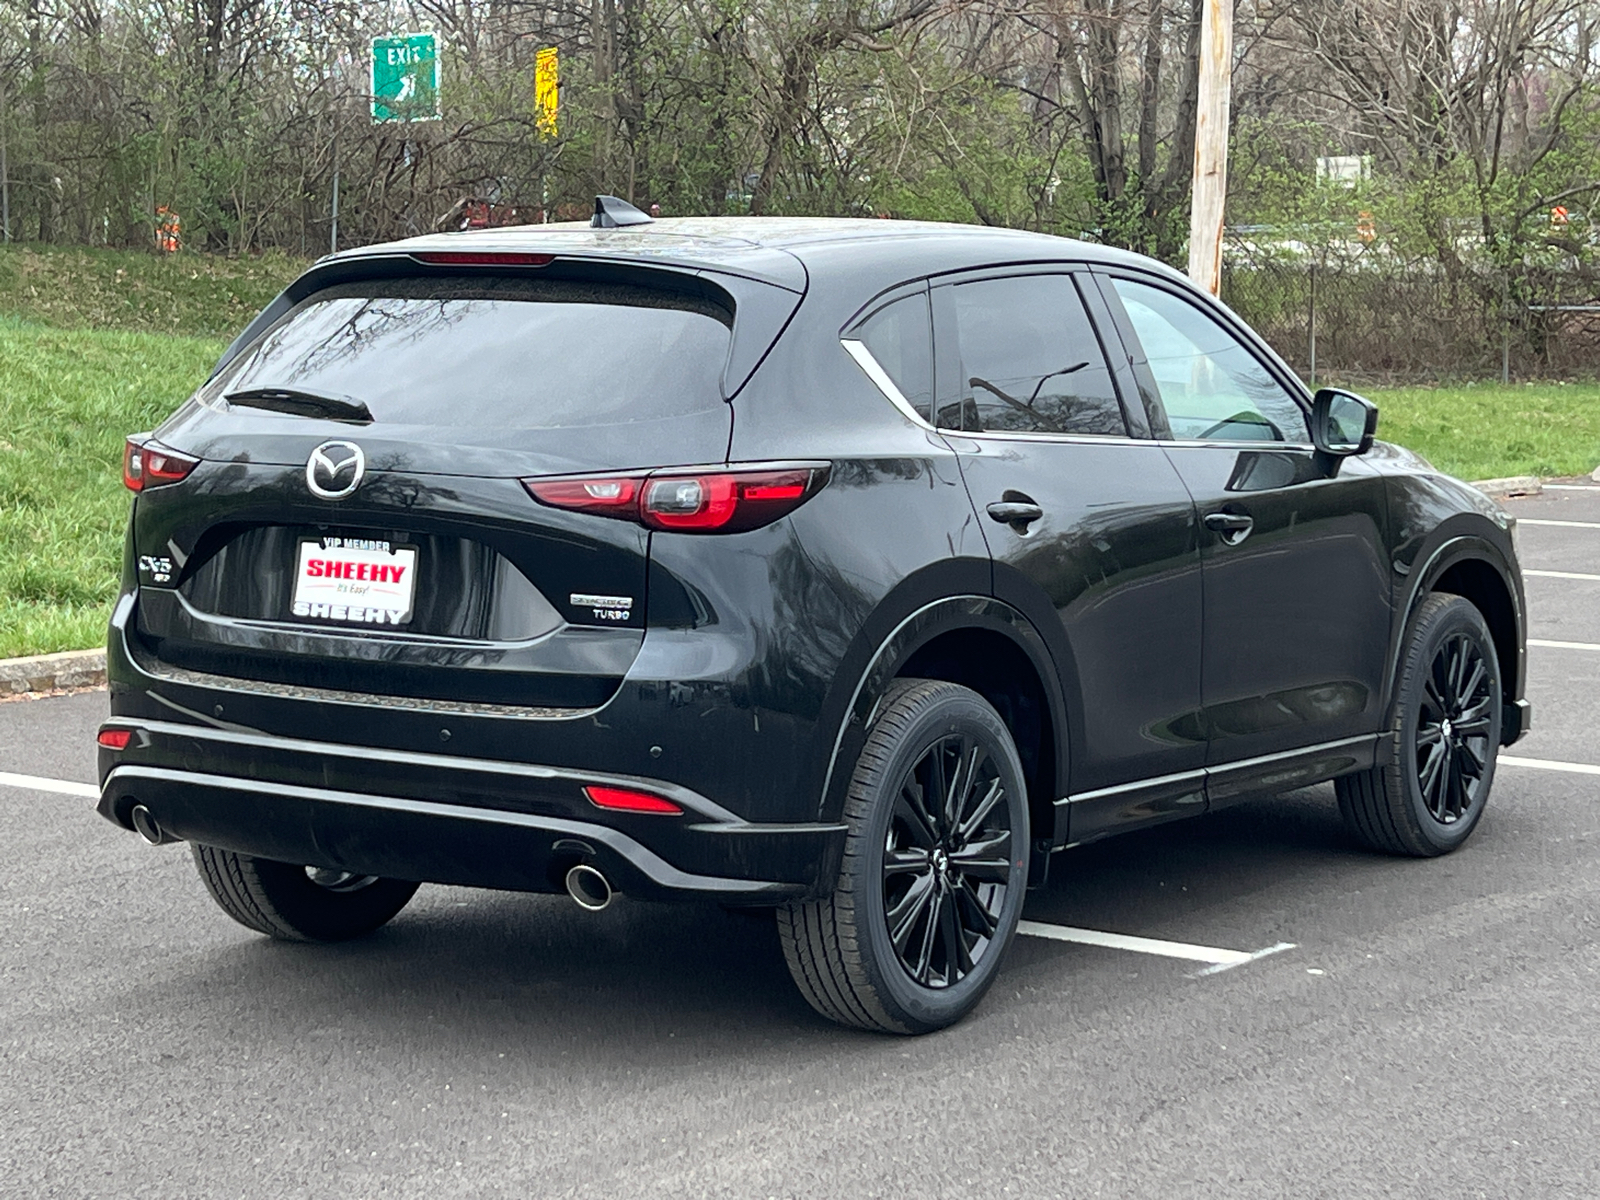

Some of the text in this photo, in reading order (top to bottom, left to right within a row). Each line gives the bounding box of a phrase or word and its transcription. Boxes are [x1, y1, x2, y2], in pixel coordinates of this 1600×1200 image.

[387, 46, 421, 65] EXIT
[323, 537, 390, 551] VIP MEMBER
[306, 559, 406, 584] SHEEHY
[292, 600, 406, 625] SHEEHY
[592, 609, 630, 620] TURBO
